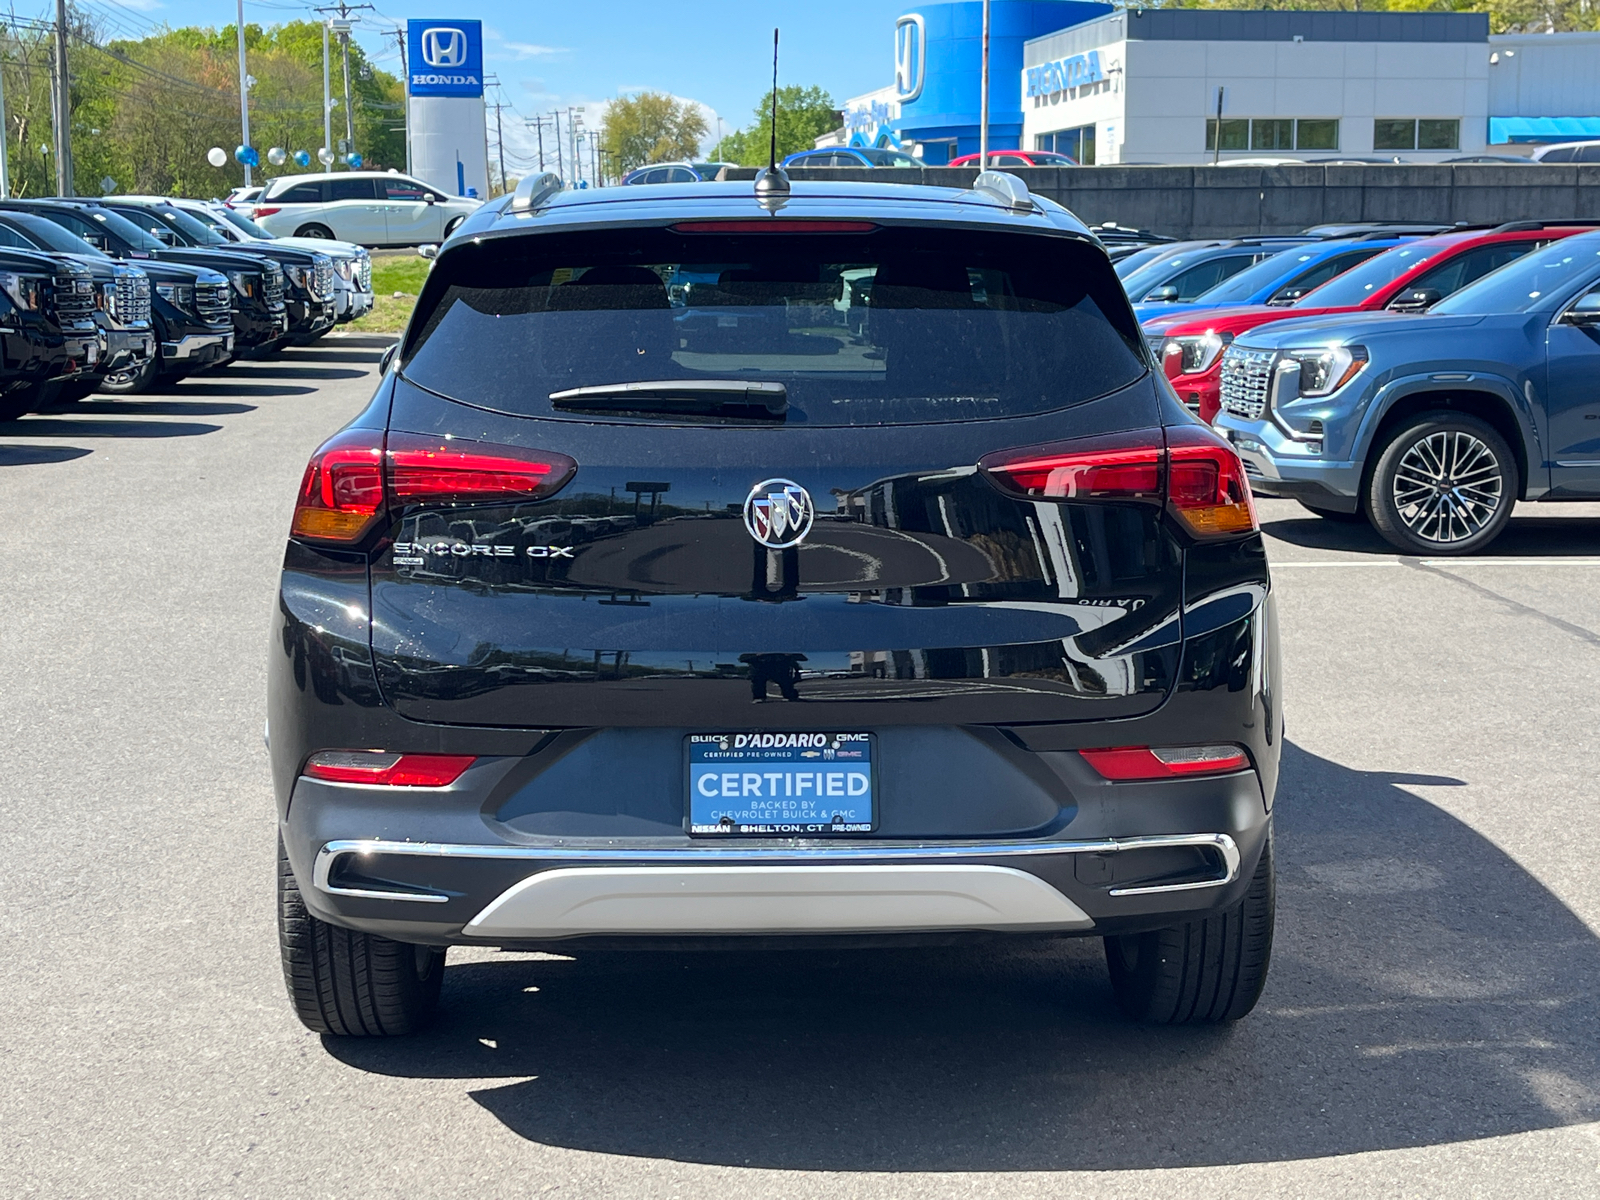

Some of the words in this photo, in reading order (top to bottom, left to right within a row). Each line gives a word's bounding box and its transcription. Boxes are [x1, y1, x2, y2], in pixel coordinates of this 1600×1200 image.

[412, 74, 480, 85] HONDA
[1026, 50, 1104, 98] HONDA
[393, 542, 516, 557] ENCORE
[526, 546, 575, 558] GX
[691, 735, 729, 743] BUICK
[734, 733, 827, 748] D'ADDARIO
[836, 733, 869, 742] GMC
[697, 772, 869, 798] CERTIFIED
[751, 801, 797, 809] BACKED
[801, 801, 816, 809] BY
[711, 810, 779, 819] CHEVROLET
[782, 810, 817, 819] BUICK
[820, 811, 828, 819] &
[831, 810, 856, 819] GMC
[691, 825, 731, 833] NISSAN
[740, 824, 804, 833] SHELTON,
[806, 824, 824, 832] CT
[831, 824, 872, 832] PRE-OWNED
